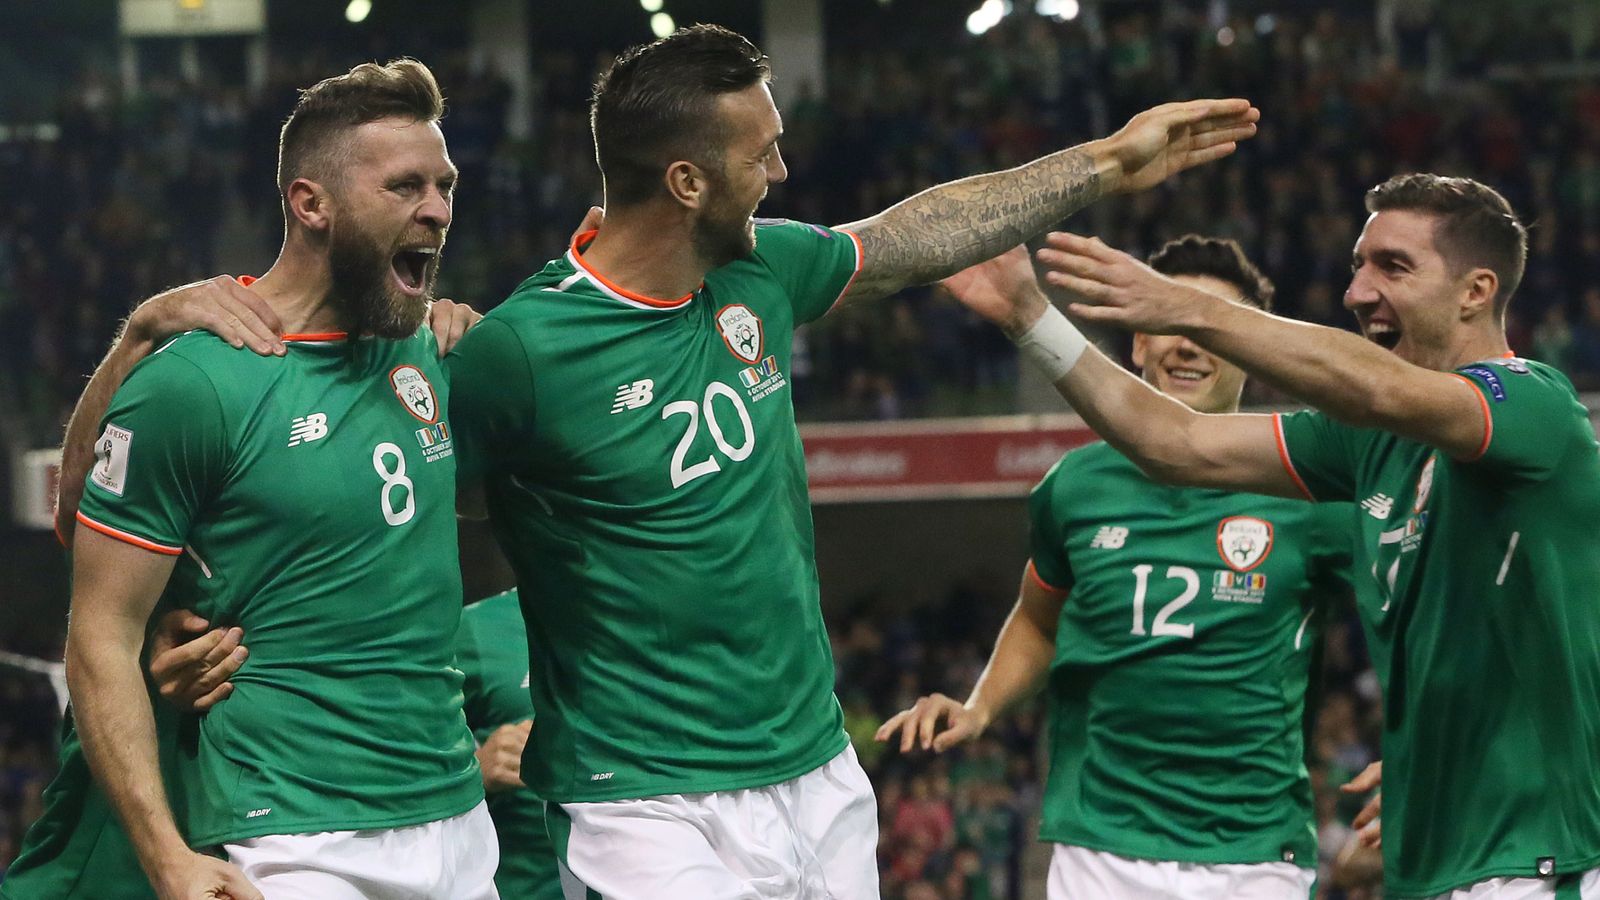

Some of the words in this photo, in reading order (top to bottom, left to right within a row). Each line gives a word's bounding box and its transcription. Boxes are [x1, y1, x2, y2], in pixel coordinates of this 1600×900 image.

[287, 412, 328, 447] NB
[610, 379, 654, 414] NB
[662, 381, 755, 489] 20
[372, 441, 416, 526] 8
[1130, 564, 1200, 638] 12
